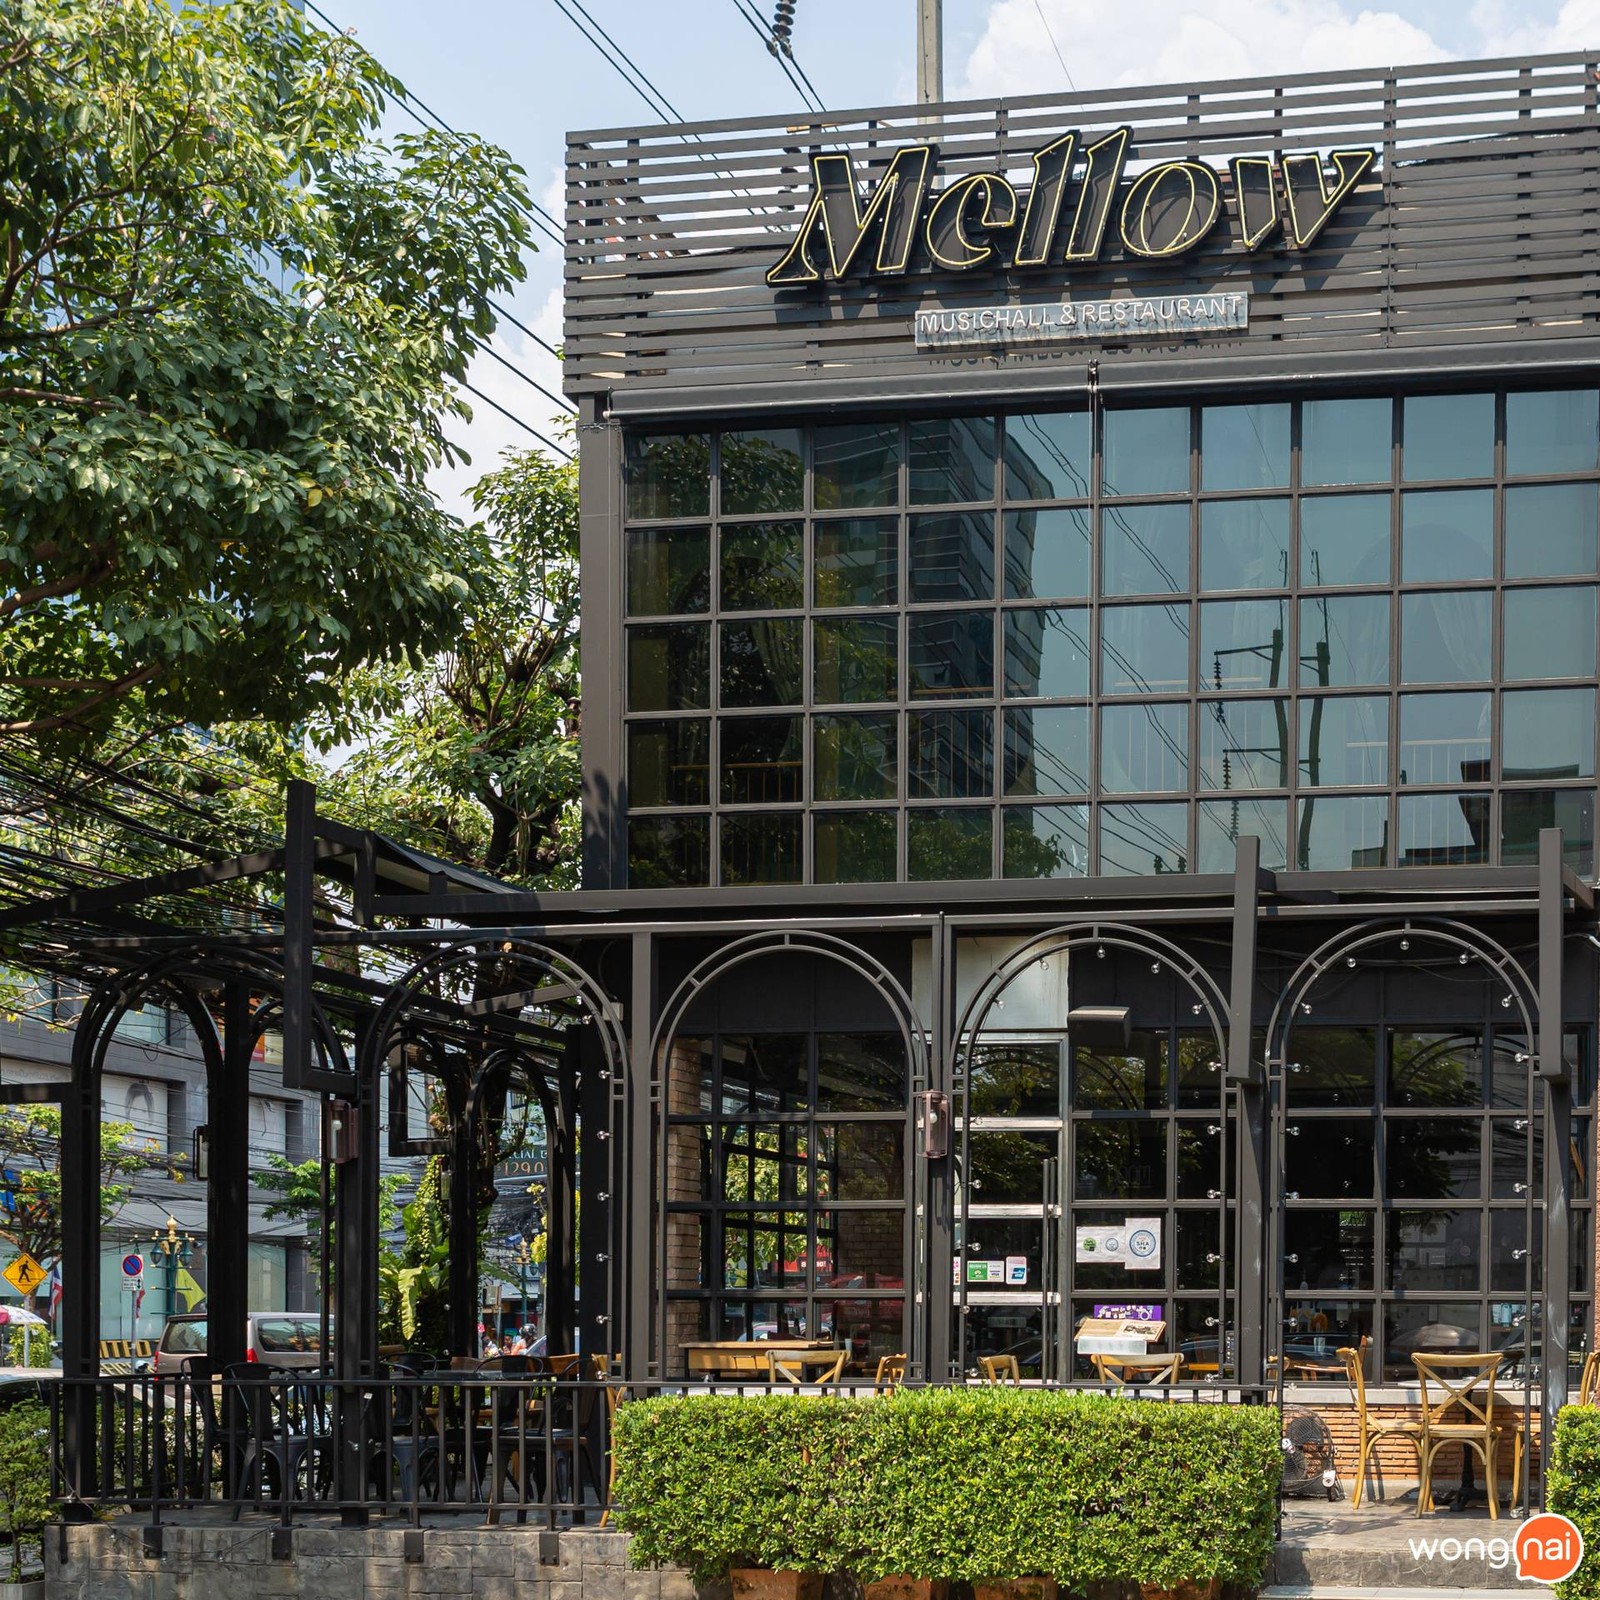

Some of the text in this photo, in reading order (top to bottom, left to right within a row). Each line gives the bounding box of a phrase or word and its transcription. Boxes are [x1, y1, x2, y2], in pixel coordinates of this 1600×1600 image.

[766, 125, 1376, 288] Mellow
[920, 295, 1241, 333] MUSICHALL & RESTAURANT
[100, 1340, 152, 1358] ITED
